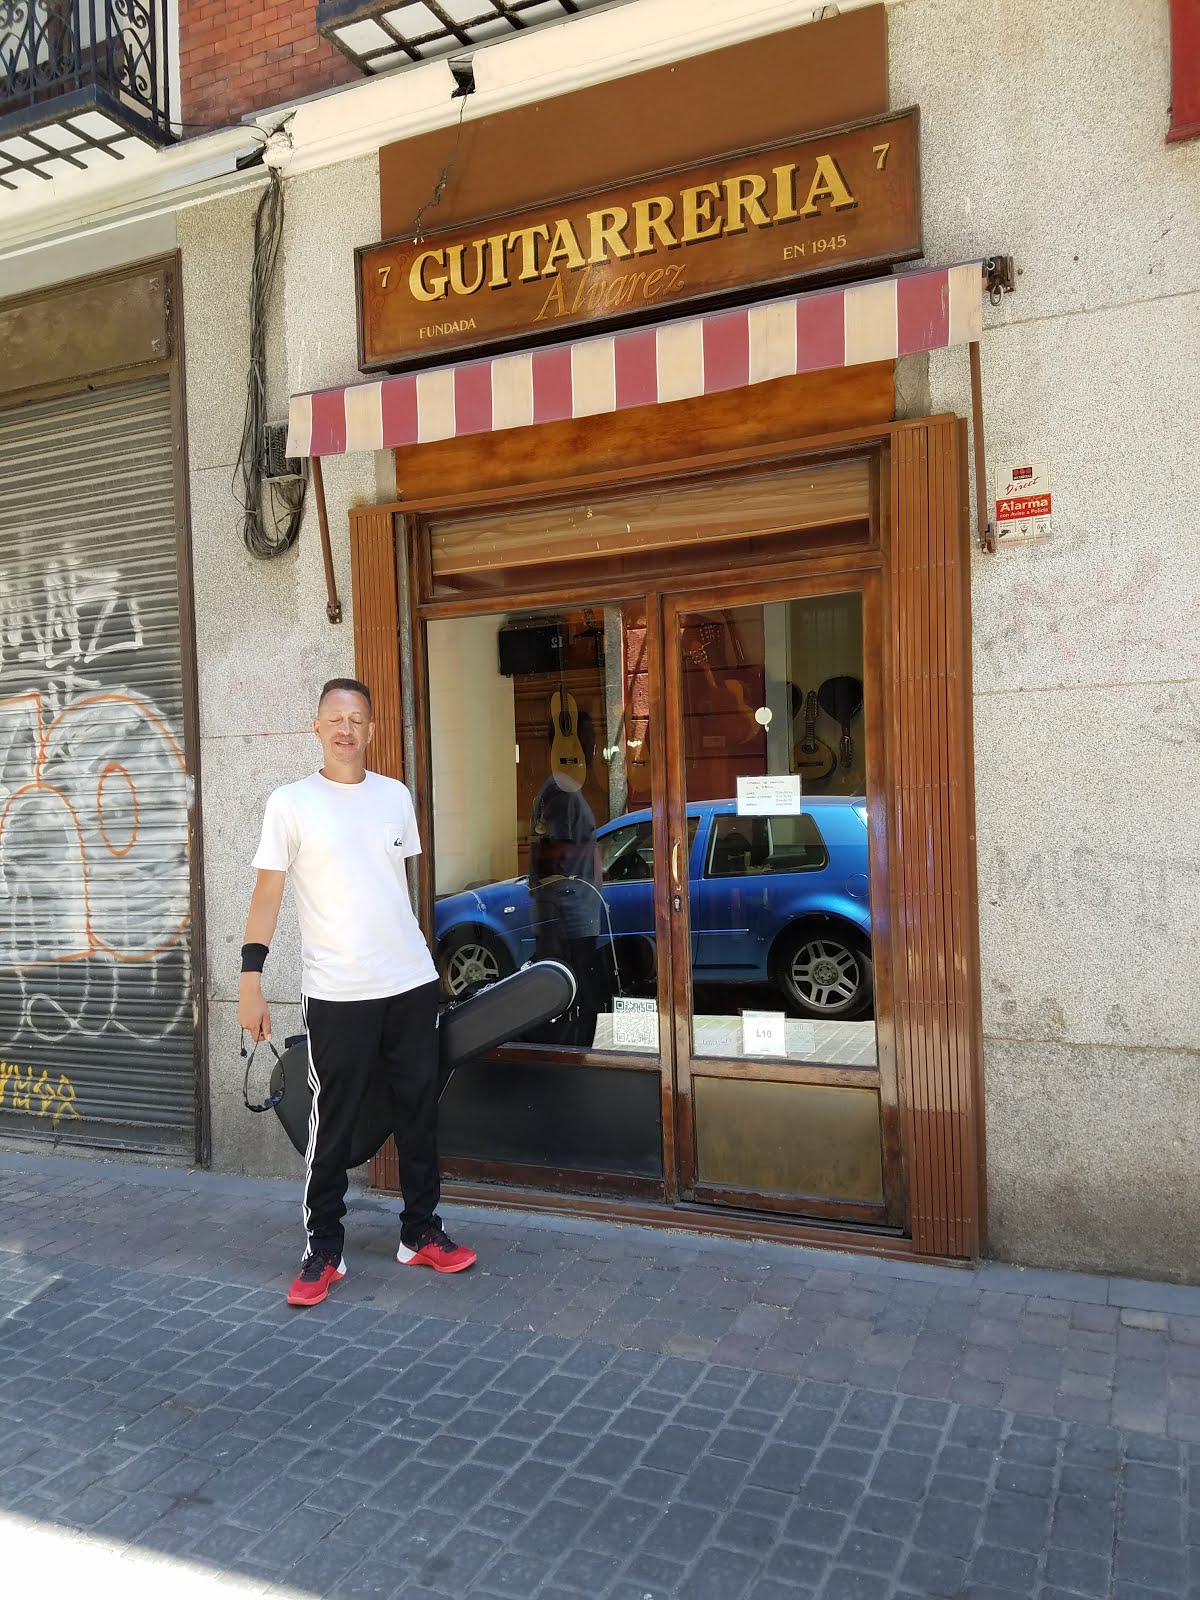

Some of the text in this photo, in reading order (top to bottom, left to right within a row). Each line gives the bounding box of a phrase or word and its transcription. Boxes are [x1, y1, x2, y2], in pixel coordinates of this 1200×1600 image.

[872, 143, 890, 169] 7
[409, 154, 856, 302] GUITARRERIA
[783, 235, 847, 260] EN 1945
[378, 266, 391, 288] 7
[533, 264, 686, 323] Alvarez
[419, 318, 477, 339] FUNDADA
[1000, 499, 1048, 513] Alarma
[756, 1028, 772, 1039] L10
